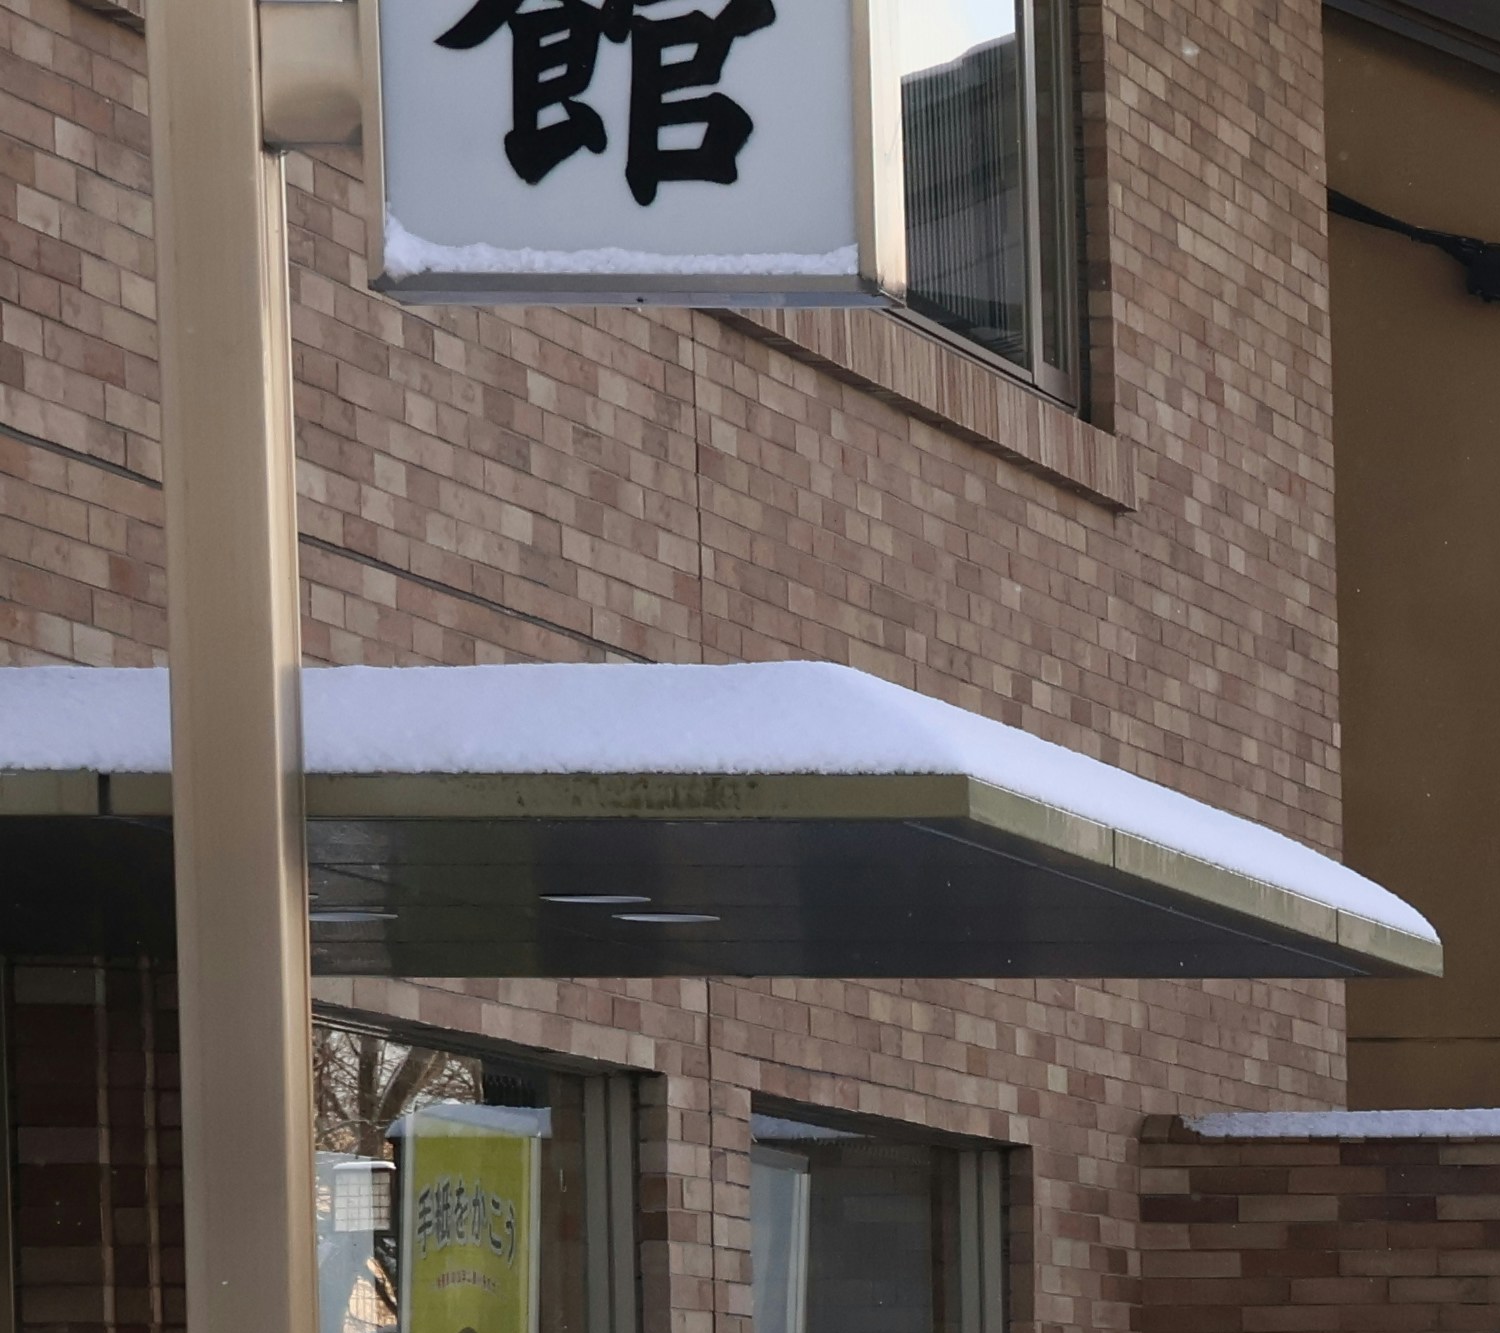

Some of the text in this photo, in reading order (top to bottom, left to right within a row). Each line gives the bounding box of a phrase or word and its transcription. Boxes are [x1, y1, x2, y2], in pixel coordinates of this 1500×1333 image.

[435, 0, 776, 206] 館
[417, 1175, 516, 1268] 手紙をかこう
